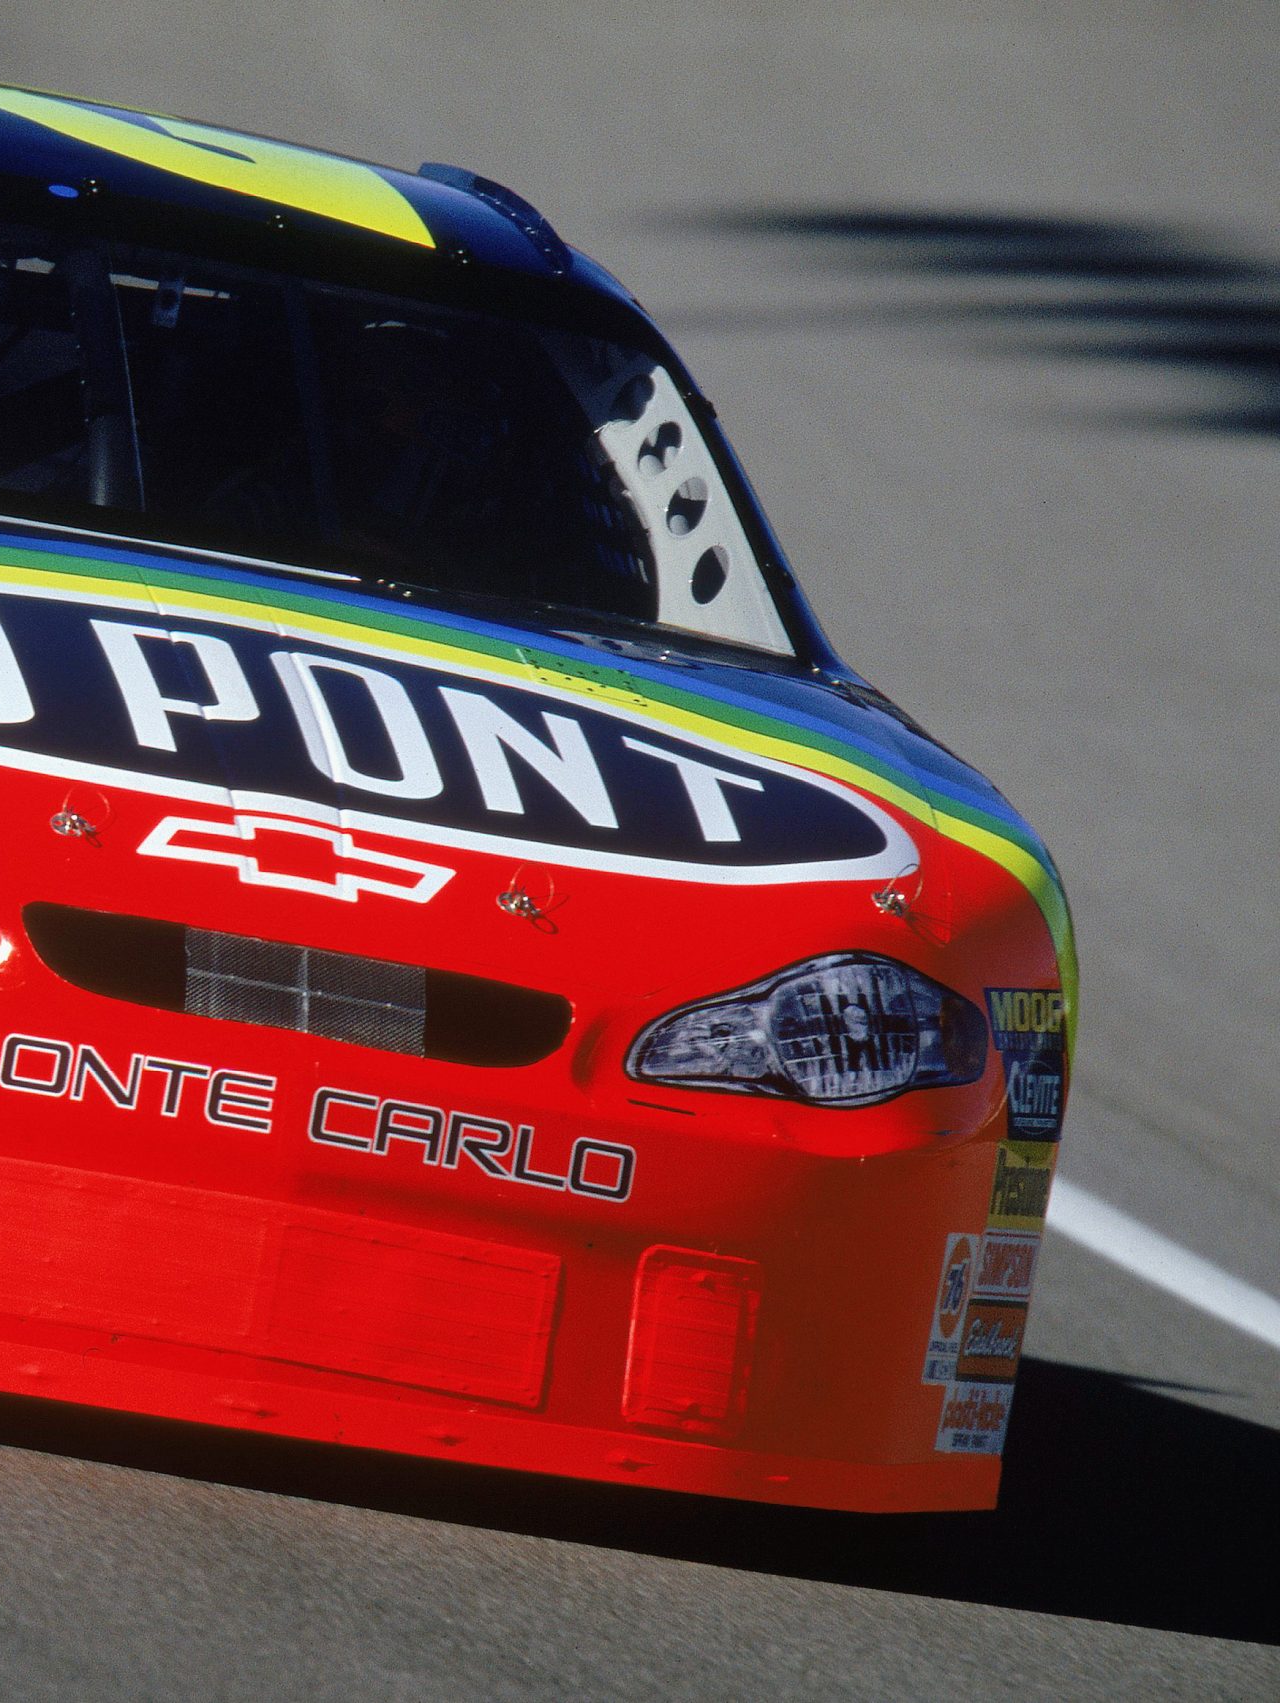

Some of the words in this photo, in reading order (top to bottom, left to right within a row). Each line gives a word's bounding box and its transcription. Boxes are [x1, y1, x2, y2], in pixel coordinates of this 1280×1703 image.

[89, 618, 765, 842] PONT
[990, 991, 1063, 1033] MOOG
[308, 1086, 637, 1203] CARLO
